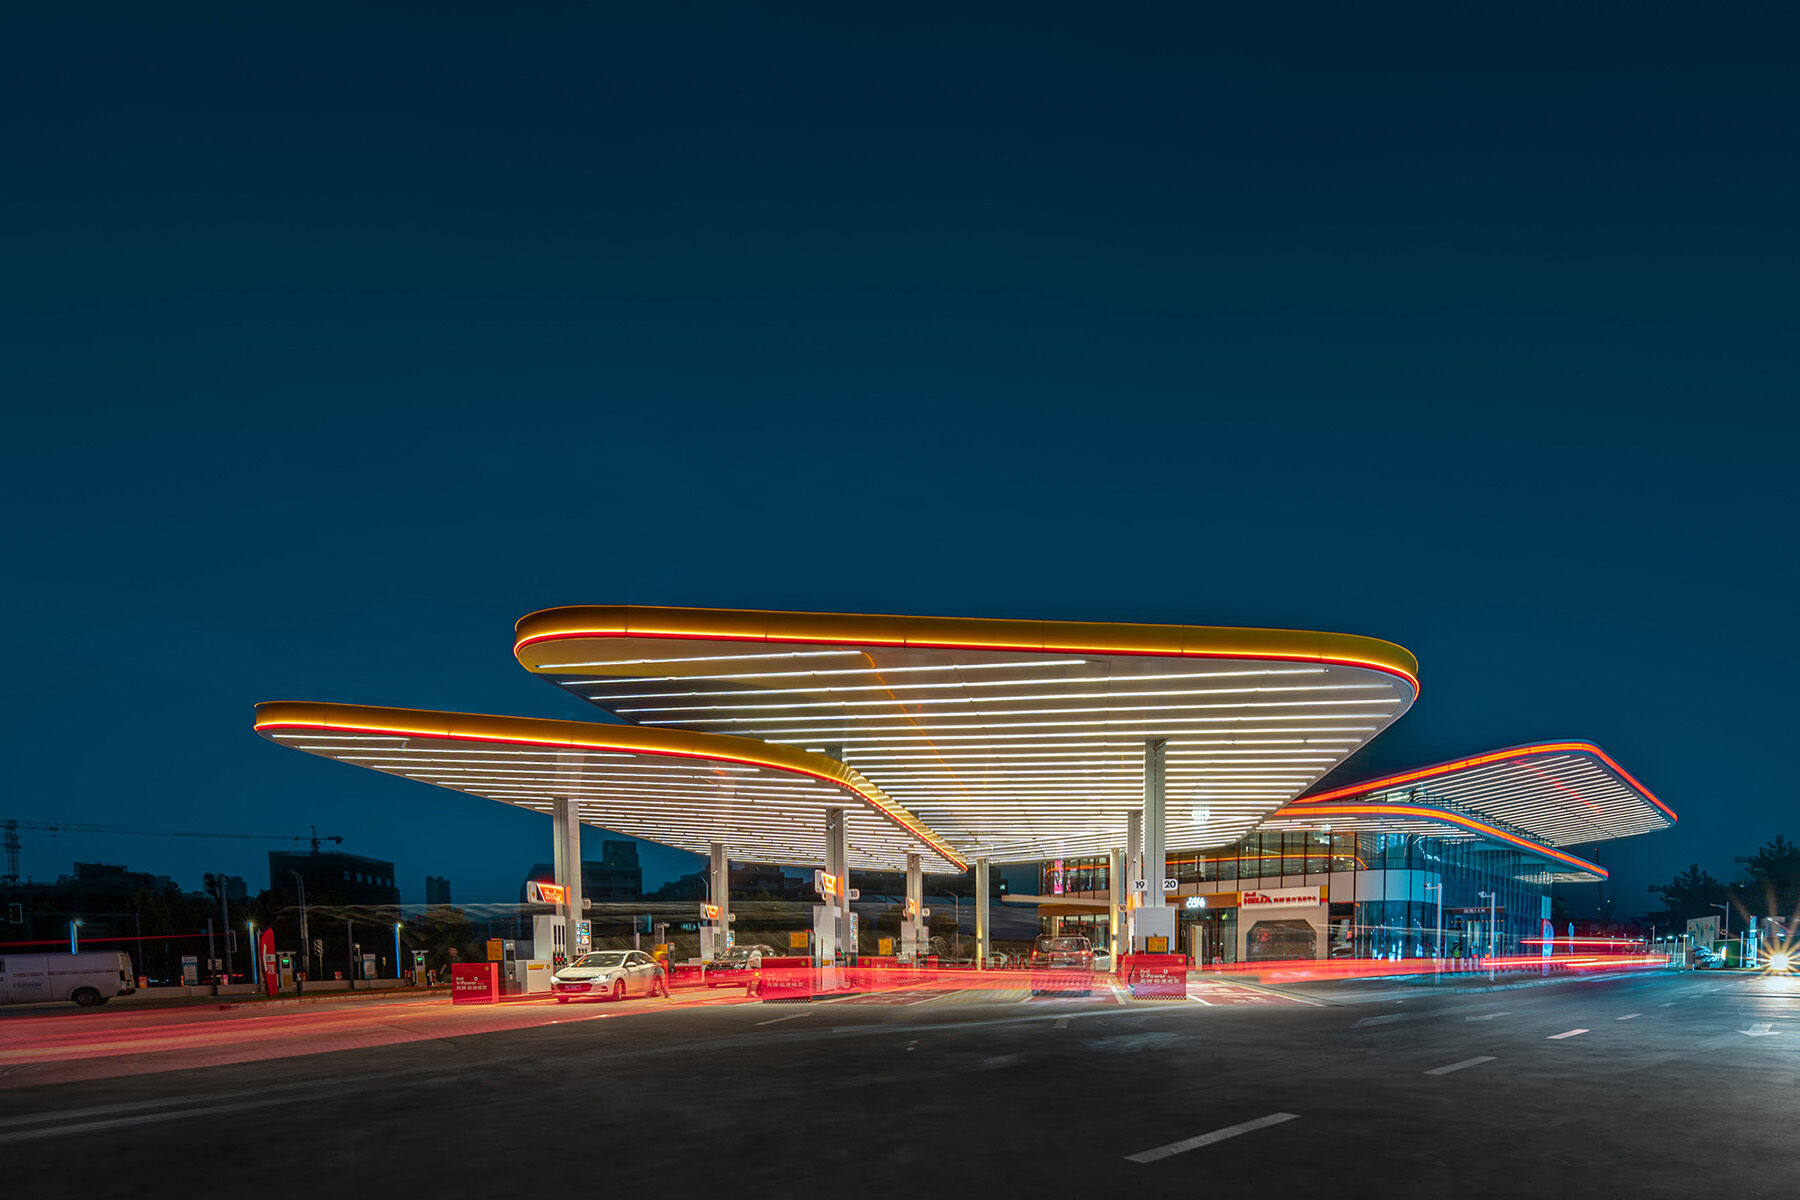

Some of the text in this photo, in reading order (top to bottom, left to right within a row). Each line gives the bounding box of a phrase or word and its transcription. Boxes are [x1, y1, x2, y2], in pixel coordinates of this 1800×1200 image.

[1135, 881, 1145, 889] 19
[1164, 880, 1177, 888] 20
[1243, 895, 1272, 905] HELIX
